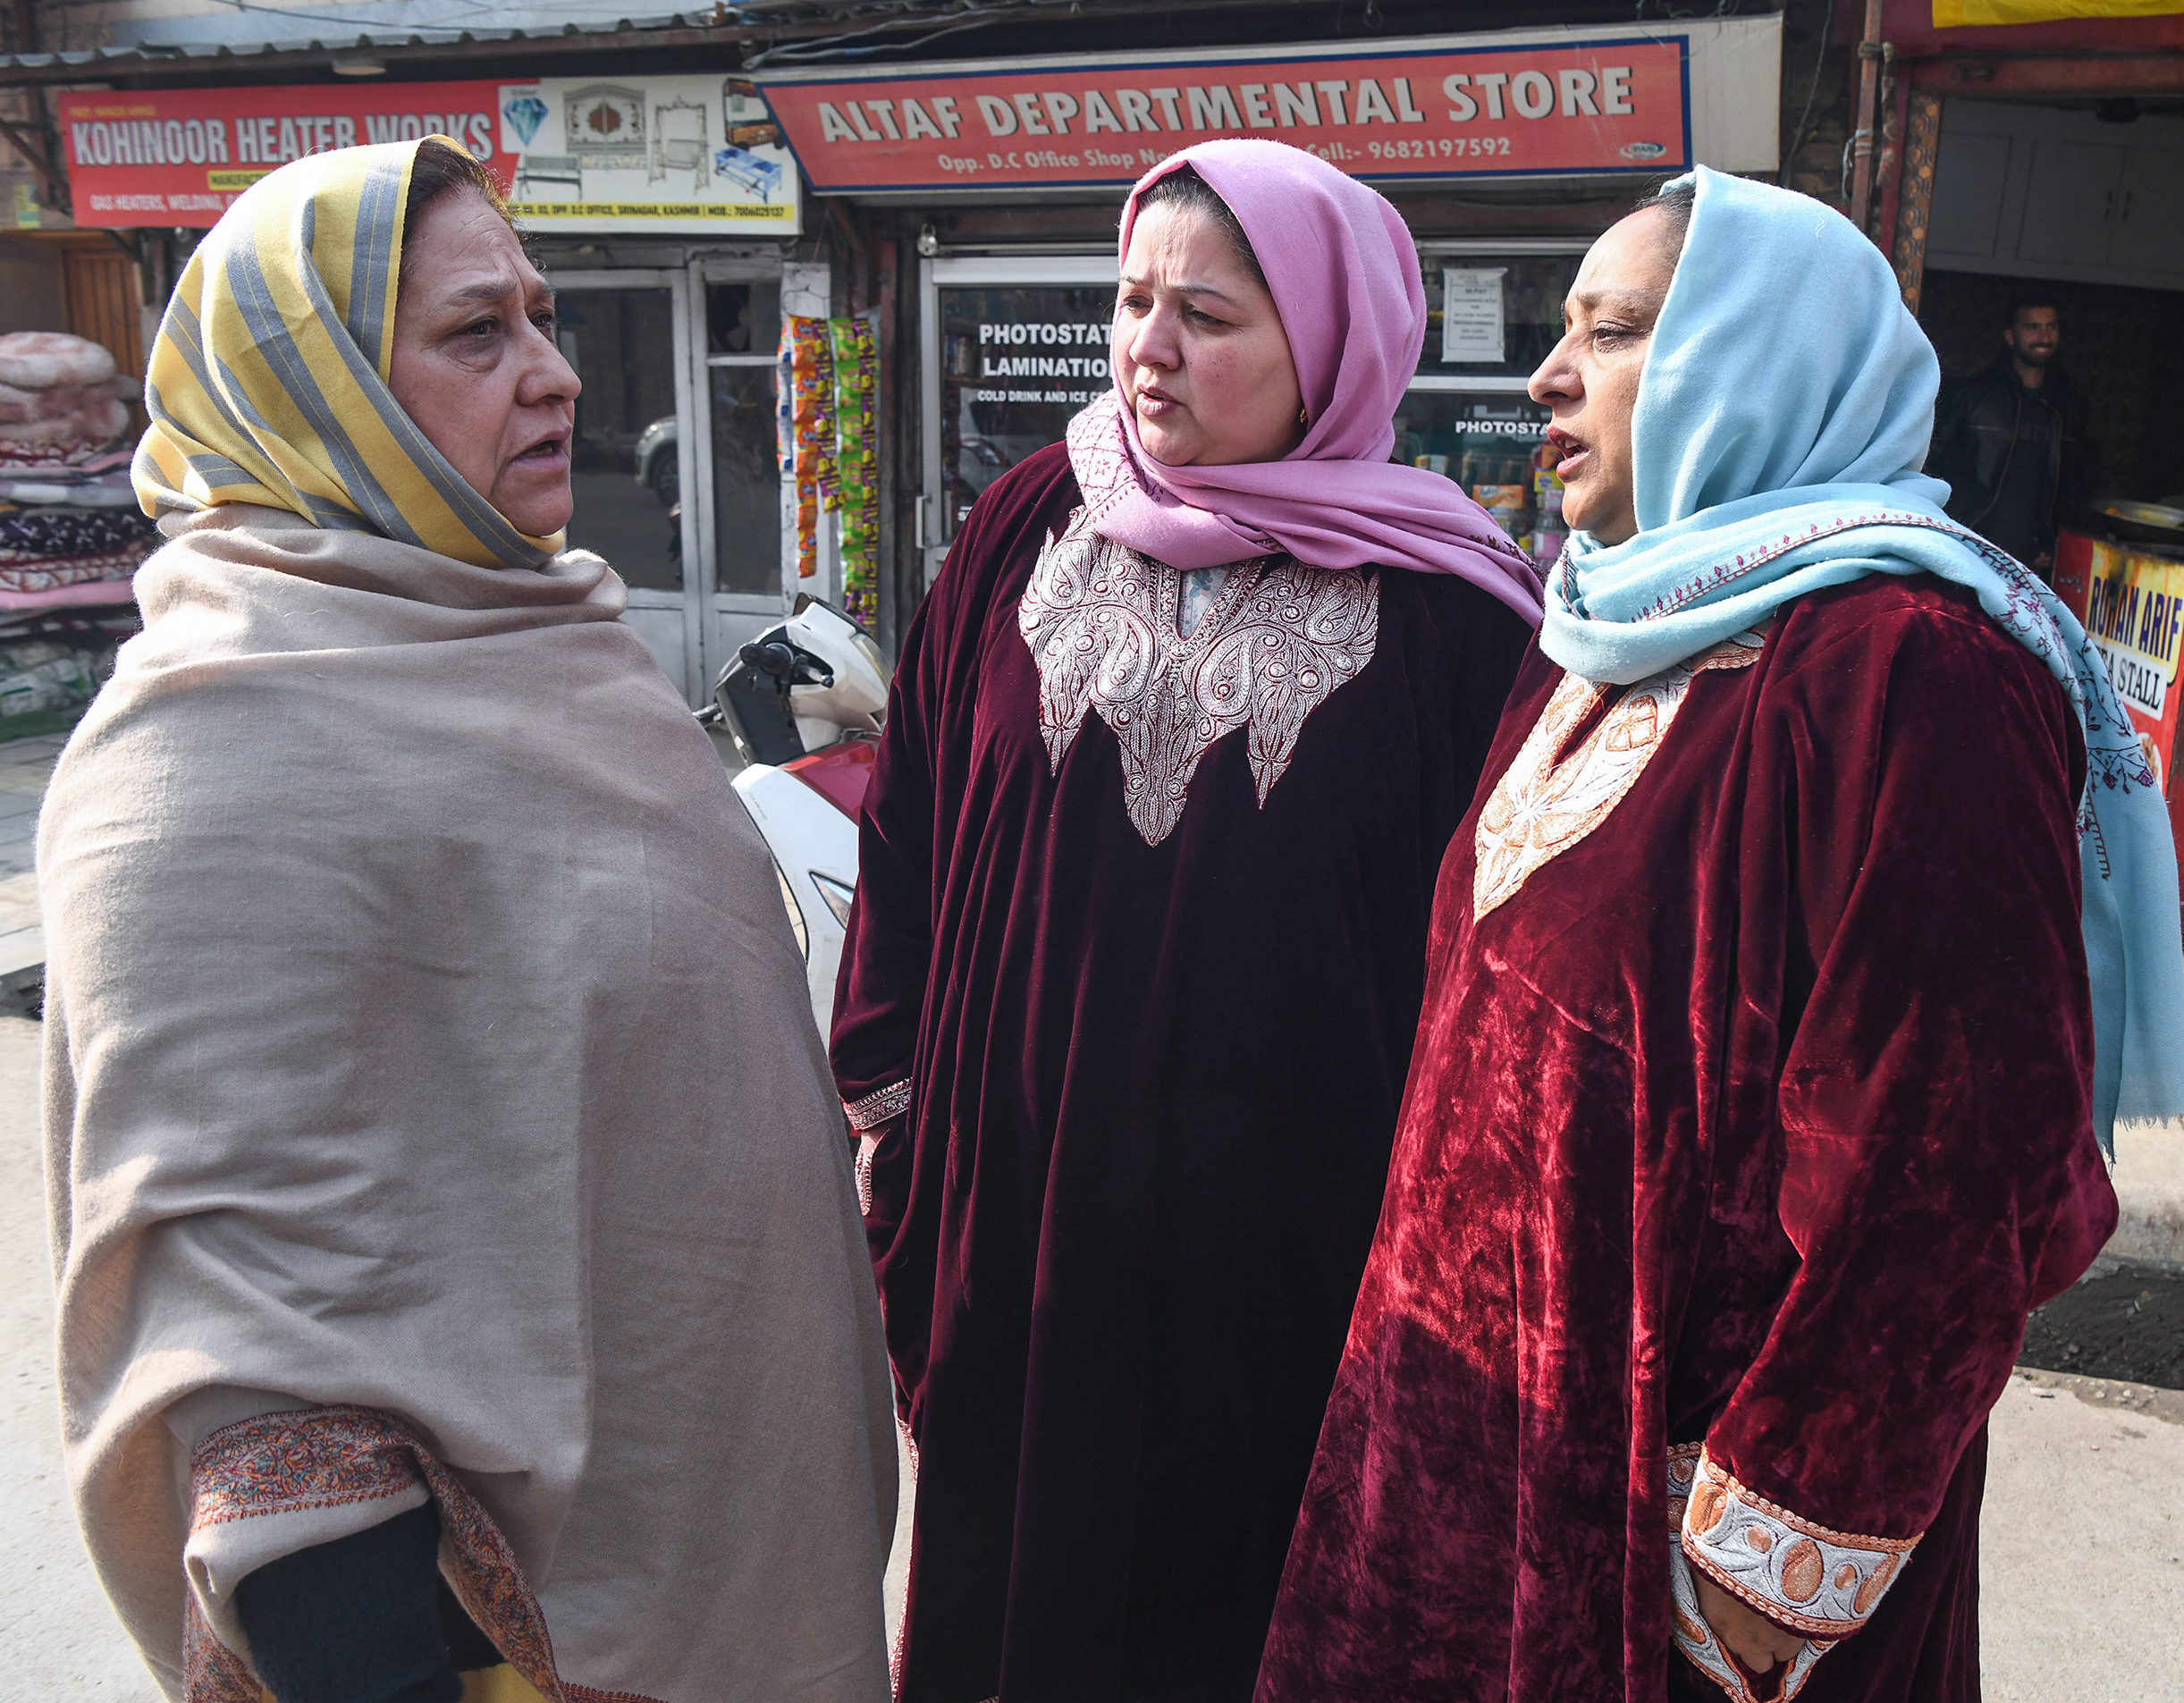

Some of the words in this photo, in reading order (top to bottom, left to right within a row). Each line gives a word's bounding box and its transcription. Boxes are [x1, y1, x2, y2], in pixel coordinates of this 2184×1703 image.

[818, 97, 963, 143] ALTAF
[975, 77, 1426, 138] DEPARTMENTAL
[1442, 66, 1635, 122] STORE
[72, 119, 229, 166] KOHINOOR
[235, 115, 356, 164] HEATER
[364, 111, 494, 163] WORKS
[1367, 137, 1511, 159] 9682197592
[938, 154, 984, 173] Opp.
[986, 152, 1021, 169] D.C
[1025, 150, 1080, 168] Office
[1084, 149, 1134, 169] Shop
[663, 206, 700, 215] KASHMIR
[980, 324, 1112, 344] PHOTOSTAT
[984, 357, 1112, 377] LAMINATIO
[977, 391, 1007, 402] COLD
[1008, 391, 1042, 402] DRINK
[1043, 391, 1067, 402] AND
[1068, 392, 1088, 402] ICE
[1455, 421, 1548, 435] PHOTOSTA
[2139, 591, 2182, 662] ARIF
[2118, 657, 2161, 711] STALL
